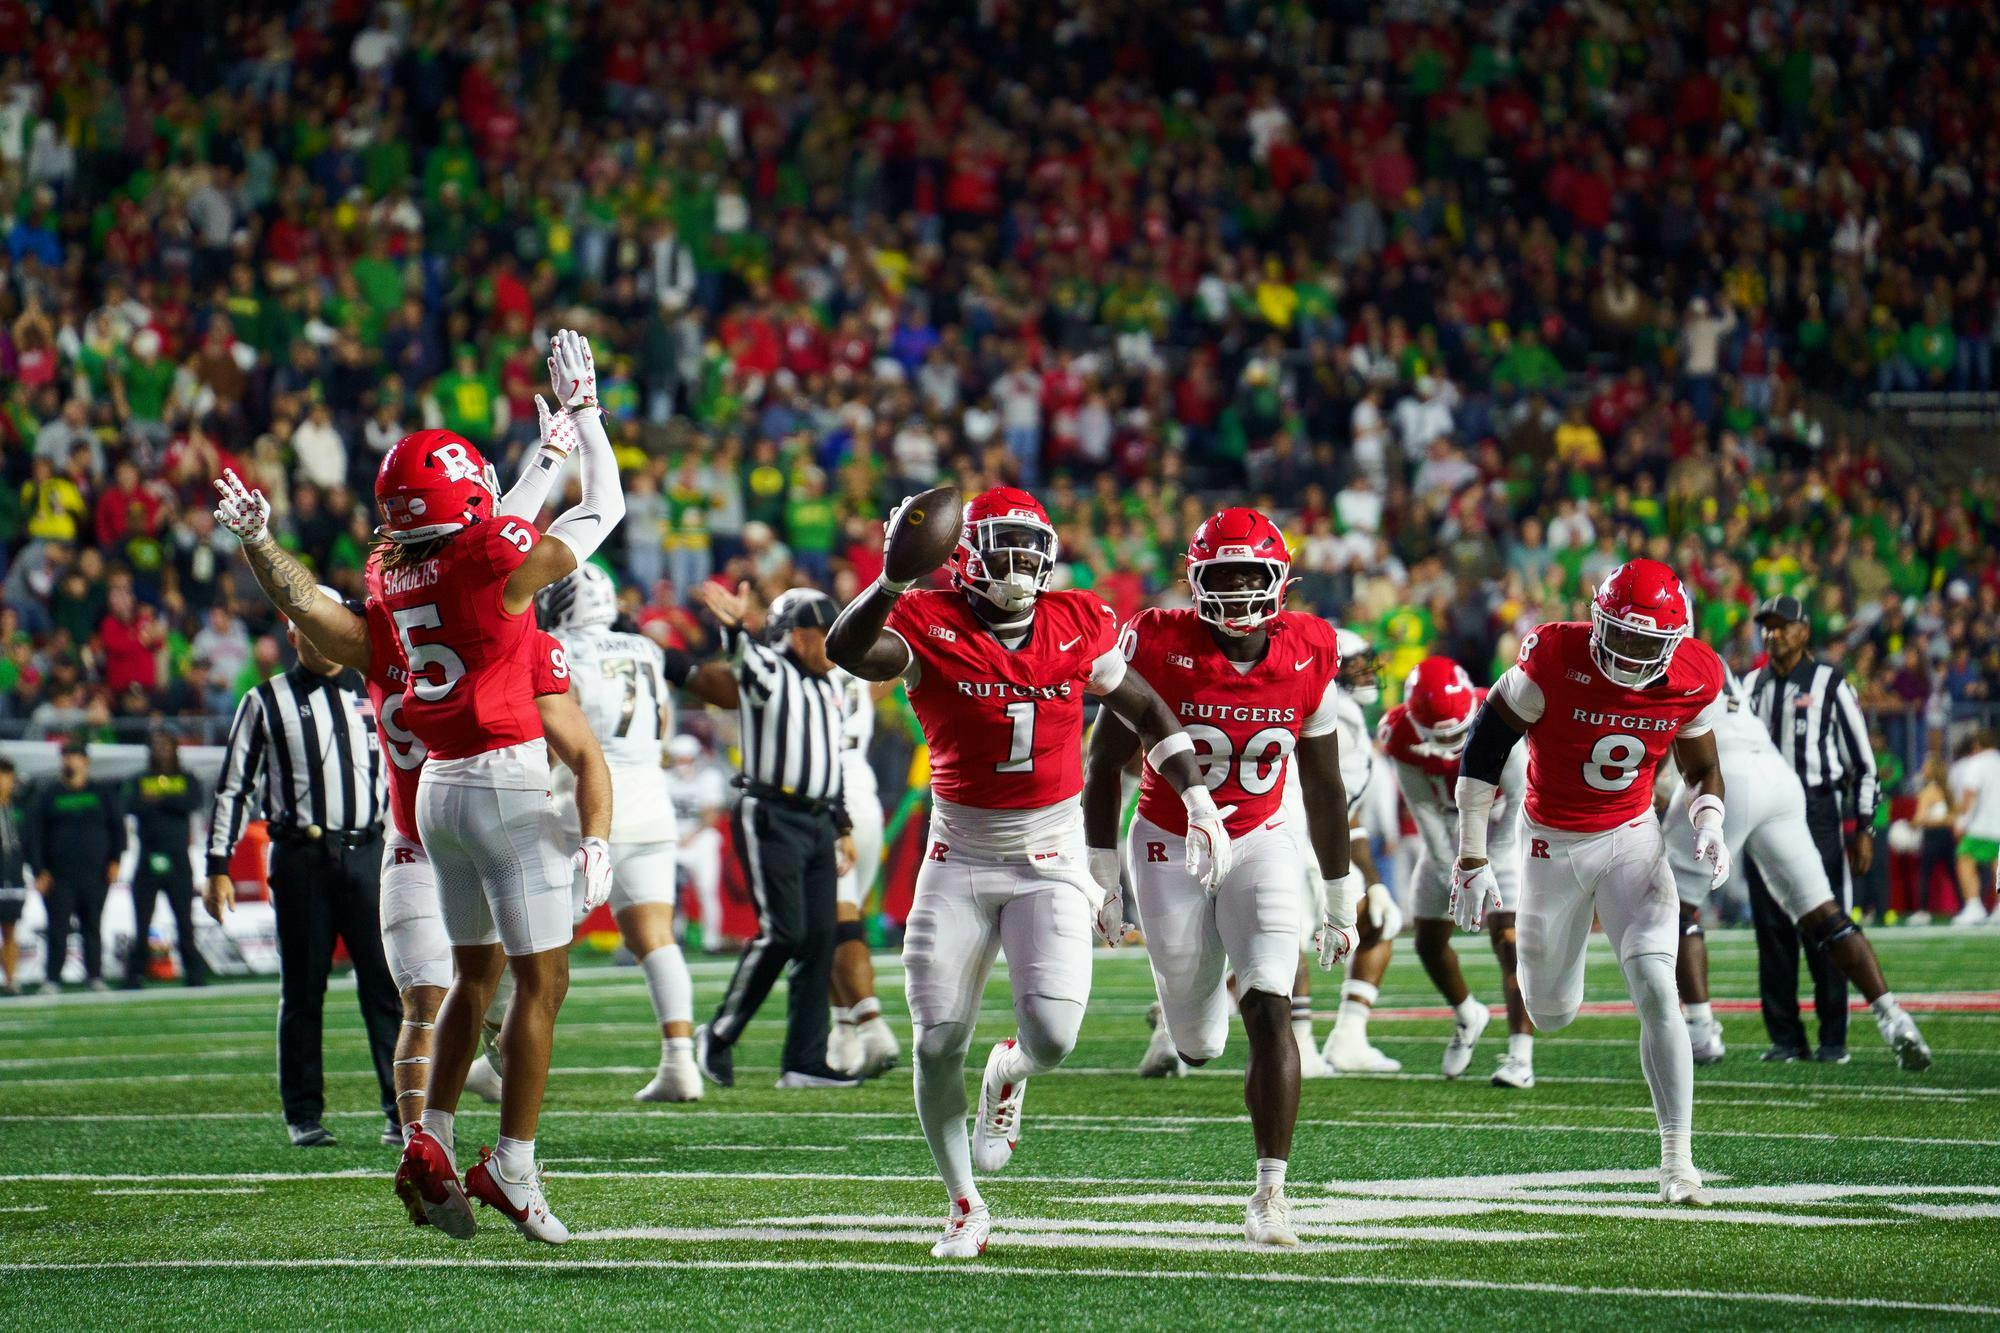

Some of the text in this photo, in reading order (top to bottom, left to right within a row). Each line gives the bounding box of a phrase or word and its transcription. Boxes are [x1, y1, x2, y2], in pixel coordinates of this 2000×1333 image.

[432, 442, 479, 483] R
[500, 521, 533, 553] 5
[384, 558, 440, 596] SANDERS
[392, 603, 467, 701] 5
[1519, 632, 1539, 662] 8
[550, 648, 572, 679] 9
[957, 680, 1072, 700] RUTGERS
[1179, 701, 1296, 723] RUTGERS
[1572, 708, 1681, 732] RUTGERS
[995, 701, 1035, 773] 1
[1183, 723, 1297, 795] 90
[1581, 733, 1647, 793] 8
[394, 847, 416, 865] R
[928, 841, 950, 863] R
[1146, 841, 1169, 863] R
[1530, 838, 1550, 859] R
